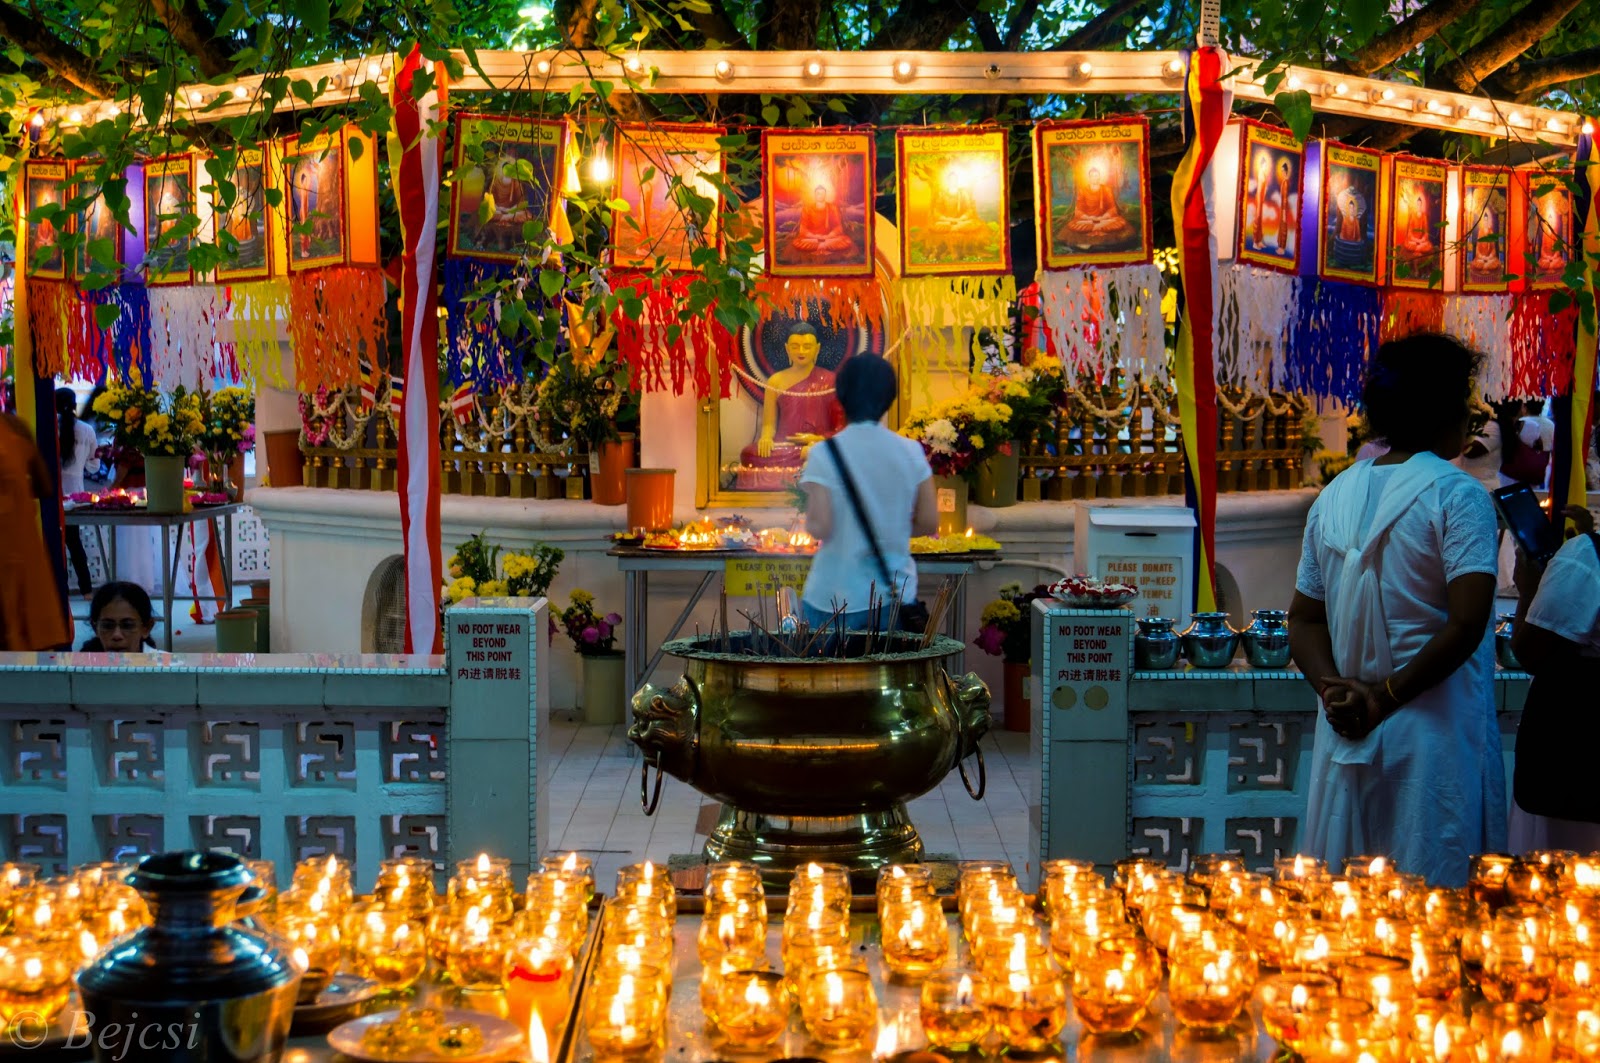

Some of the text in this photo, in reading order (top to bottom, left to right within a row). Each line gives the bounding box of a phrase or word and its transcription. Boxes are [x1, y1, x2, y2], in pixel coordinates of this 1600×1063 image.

[1101, 126, 1131, 138] සතිය
[826, 138, 856, 150] සතිය
[736, 563, 762, 571] PLEASE
[766, 563, 776, 571] DO
[779, 563, 791, 571] NOT
[1108, 563, 1173, 573] PLEASE DONATE
[782, 573, 796, 581] THIS
[1122, 576, 1137, 585] THE
[1140, 576, 1176, 586] UP-KEEP
[1142, 590, 1172, 599] TEMPLE
[458, 624, 521, 634] NO FOOT WEAR
[1059, 626, 1121, 636] NO FOOT WEAR
[473, 638, 506, 648] BEYOND
[1074, 640, 1106, 649] BEYOND
[466, 651, 512, 661] THIS POINT
[1067, 653, 1112, 663] THIS POINT
[458, 668, 521, 680] 内进请脱鞋
[1058, 669, 1121, 681] 内进请脱鞋
